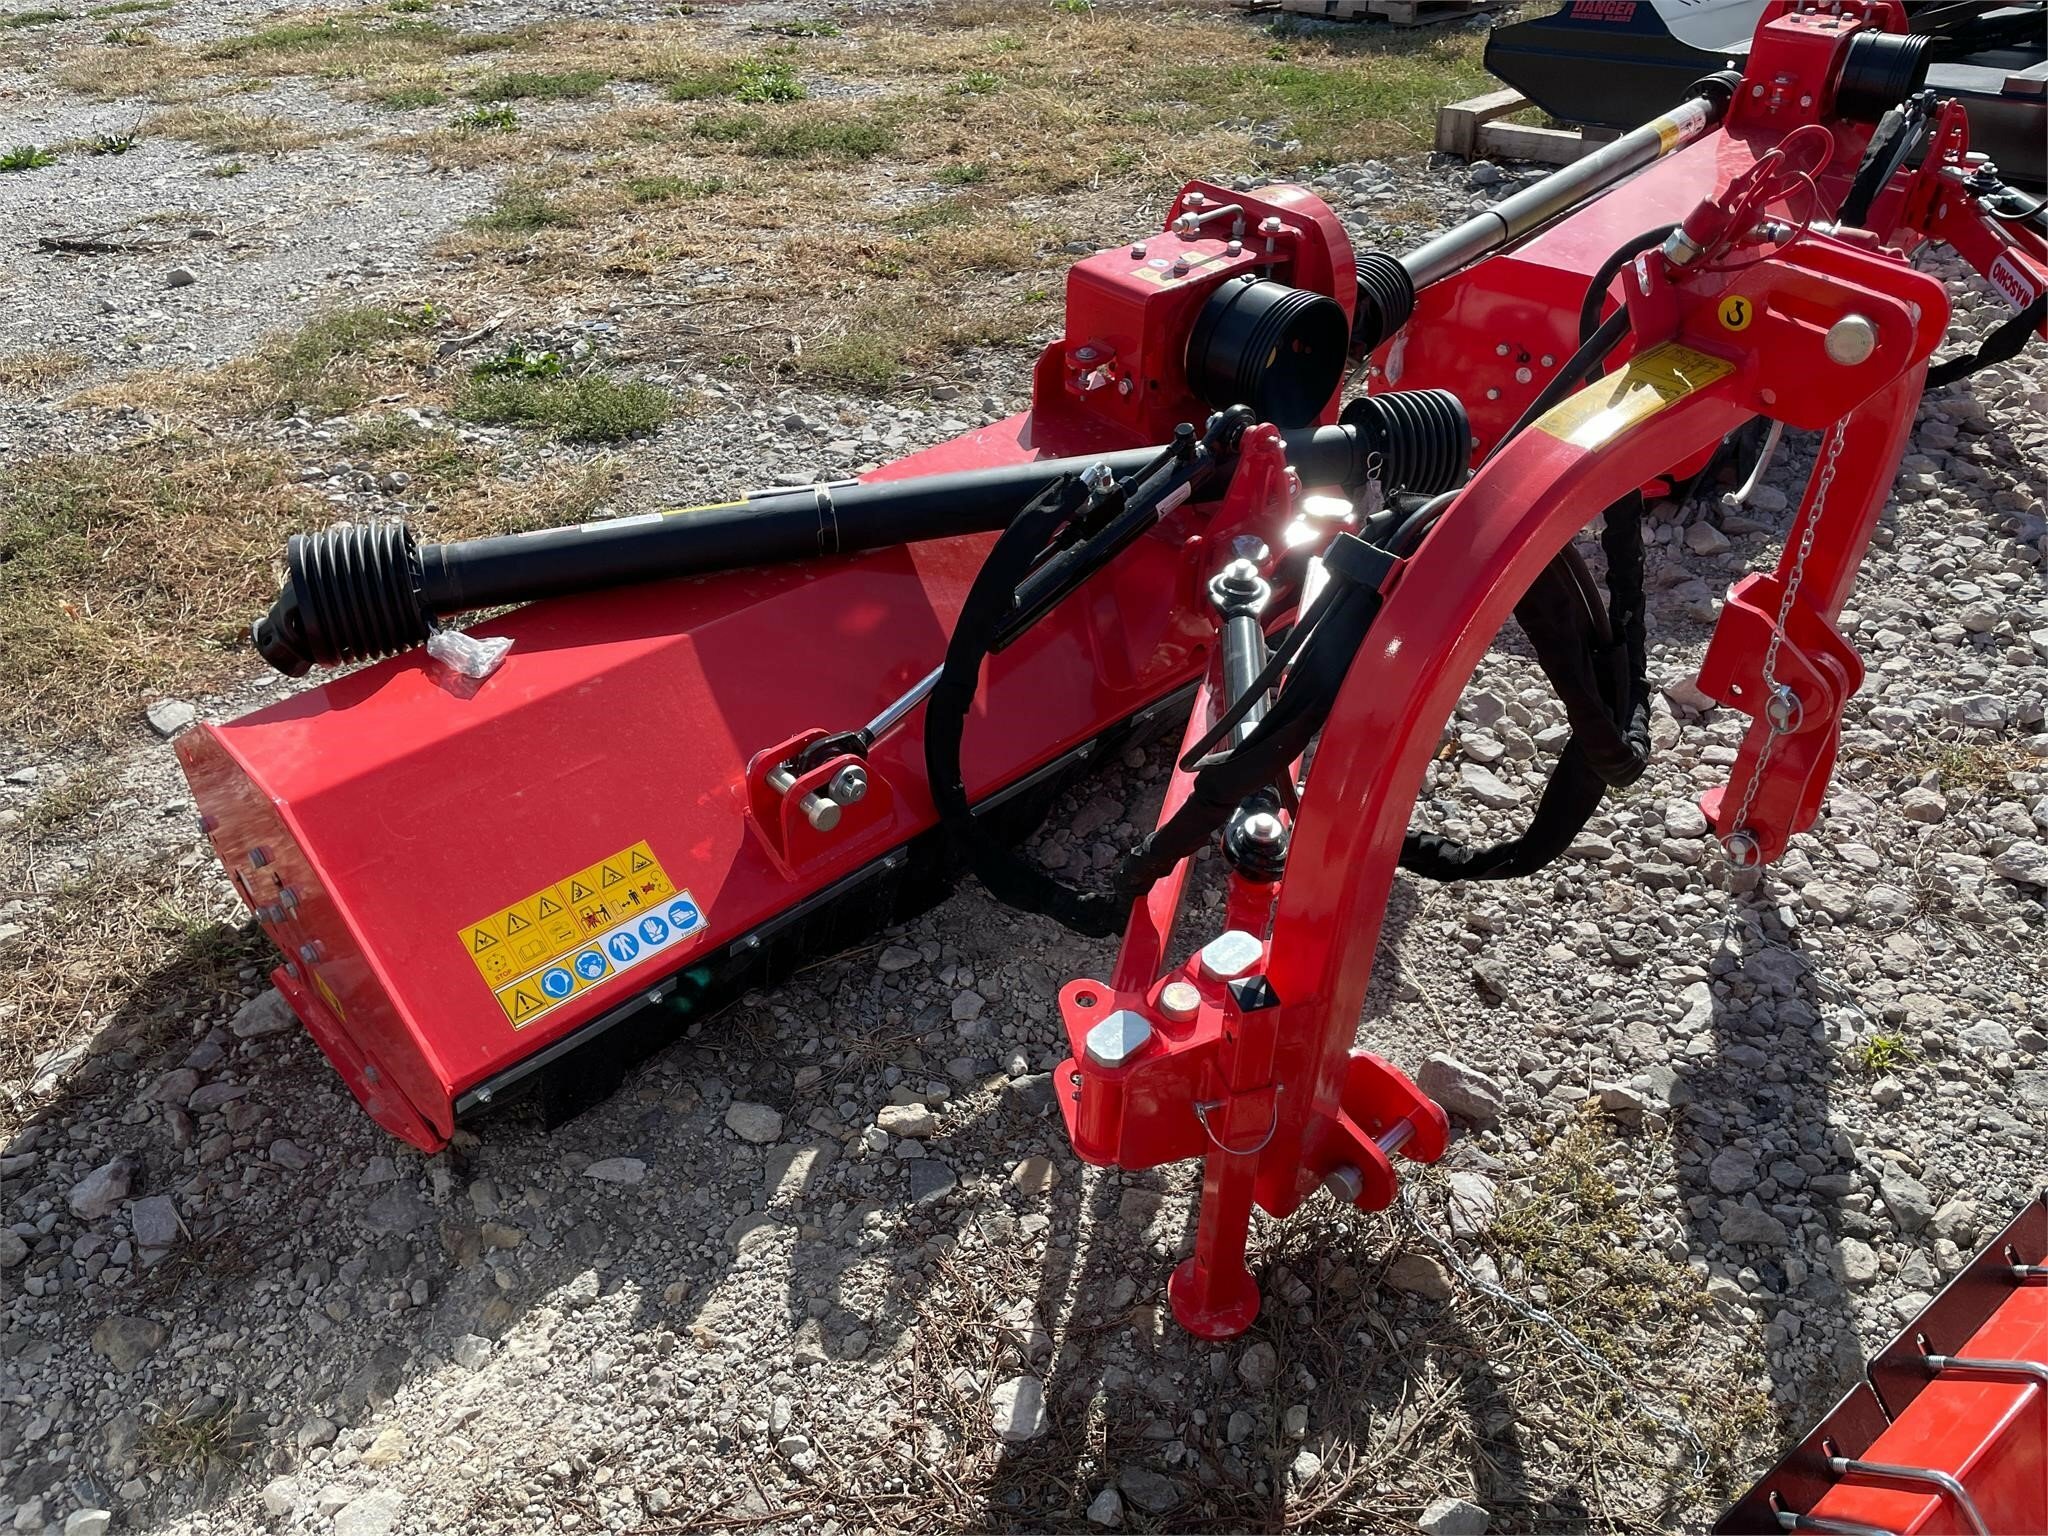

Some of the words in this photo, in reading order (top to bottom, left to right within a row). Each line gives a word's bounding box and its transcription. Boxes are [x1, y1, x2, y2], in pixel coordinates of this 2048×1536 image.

[1573, 0, 1637, 15] DANGER
[1993, 262, 2032, 308] MASCHIO
[495, 968, 512, 981] STOP
